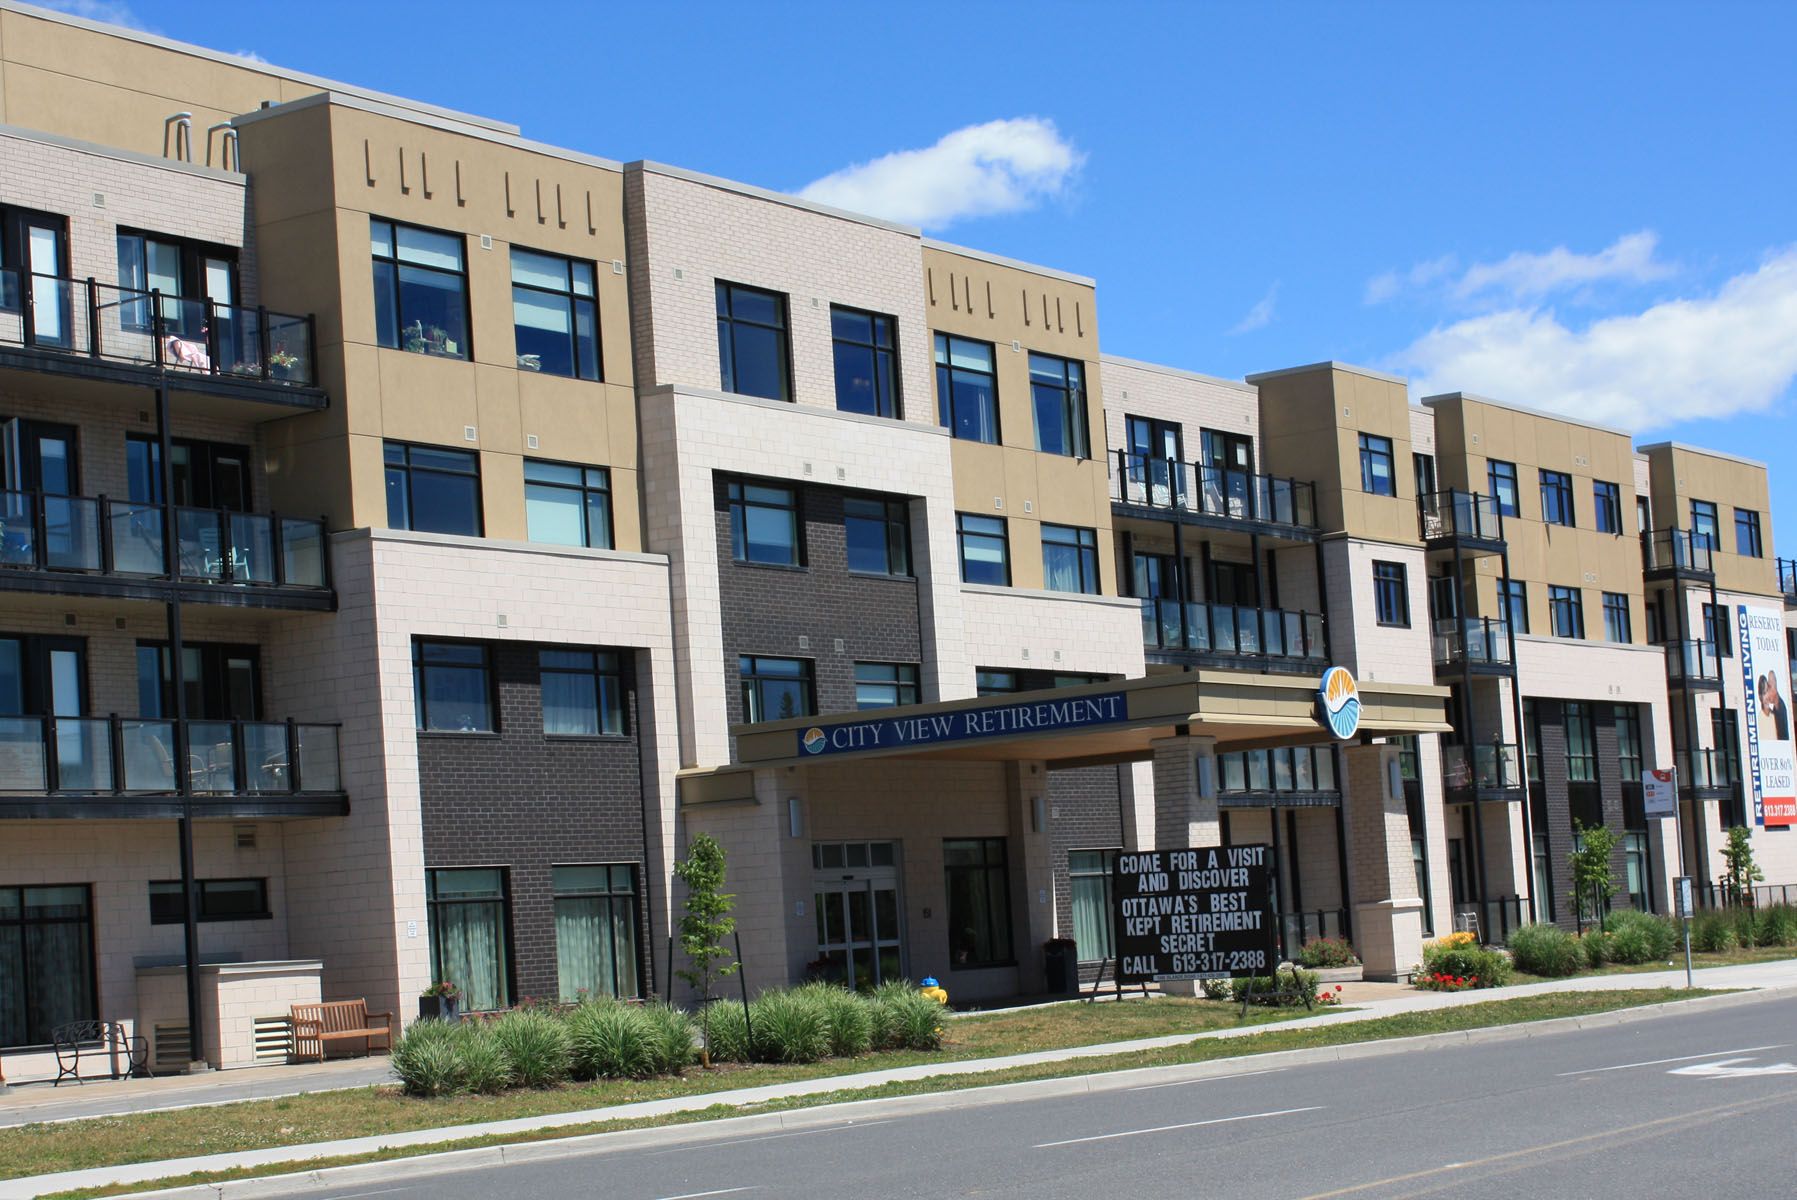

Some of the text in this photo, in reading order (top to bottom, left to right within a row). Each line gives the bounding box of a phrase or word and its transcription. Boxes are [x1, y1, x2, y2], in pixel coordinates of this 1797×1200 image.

[1749, 615, 1780, 631] RESERVE
[1756, 636, 1779, 651] TODAY
[833, 696, 1120, 748] CITY VIEW RETIREMENT
[1740, 614, 1762, 817] RETIREMENT LIVING
[1761, 758, 1779, 770] OVER
[1766, 776, 1790, 788] LEASED
[1120, 847, 1264, 874] COME FOR A VISIT
[1138, 868, 1249, 892] AND DISCOVER
[1122, 892, 1247, 917] OTTAWA'S BEST
[1126, 911, 1262, 936] KEPT RETIREMENT
[1161, 933, 1215, 953] SECRET
[1124, 951, 1265, 974] CALL 613-317-2388
